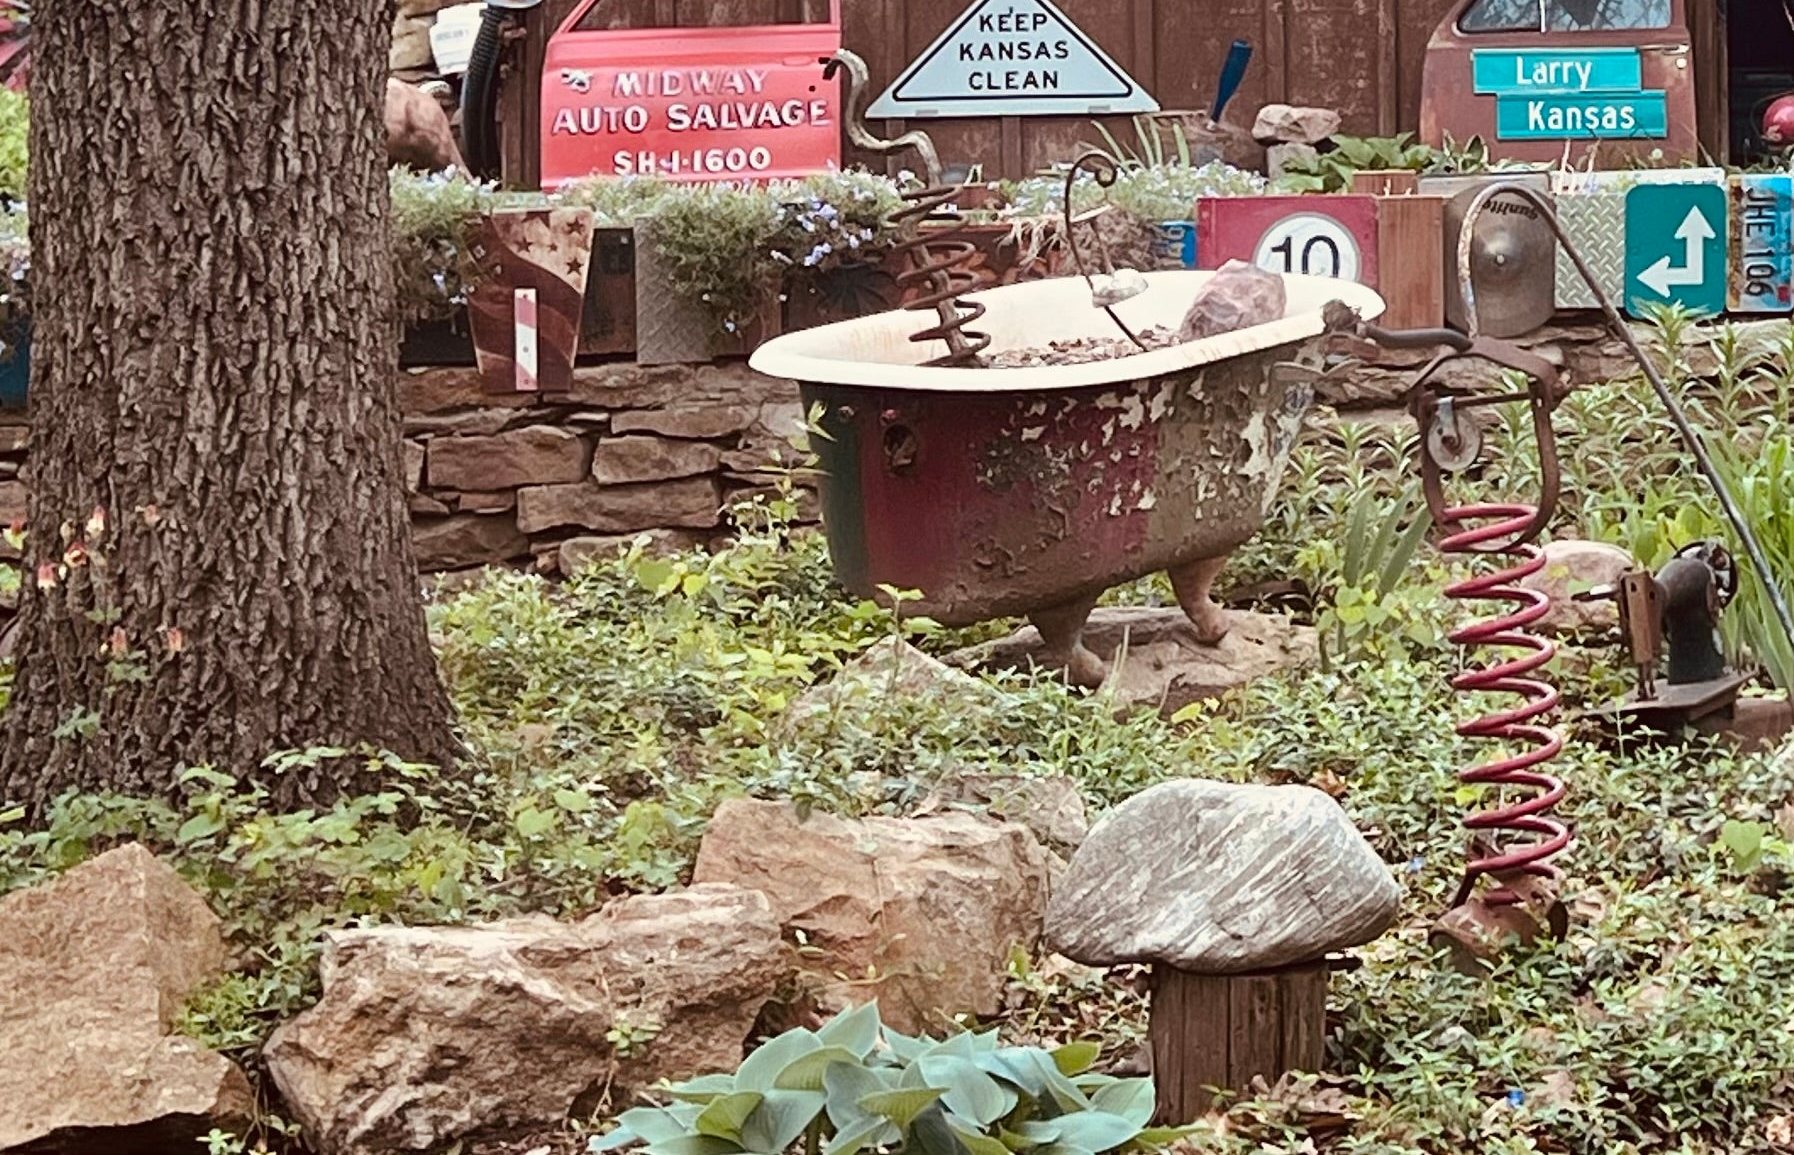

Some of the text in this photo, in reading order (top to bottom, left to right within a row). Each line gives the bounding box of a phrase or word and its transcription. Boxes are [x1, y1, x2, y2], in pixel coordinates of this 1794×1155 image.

[979, 12, 1048, 32] KEEP
[959, 40, 1069, 61] KANSAS
[612, 67, 769, 97] MIDWAY
[968, 70, 1059, 90] CLEAN
[1516, 56, 1592, 91] Larry
[552, 98, 833, 136] AUTO SALVAGE
[1528, 100, 1636, 131] Kansas
[1270, 234, 1340, 278] 10
[1744, 187, 1778, 297] JHE 106
